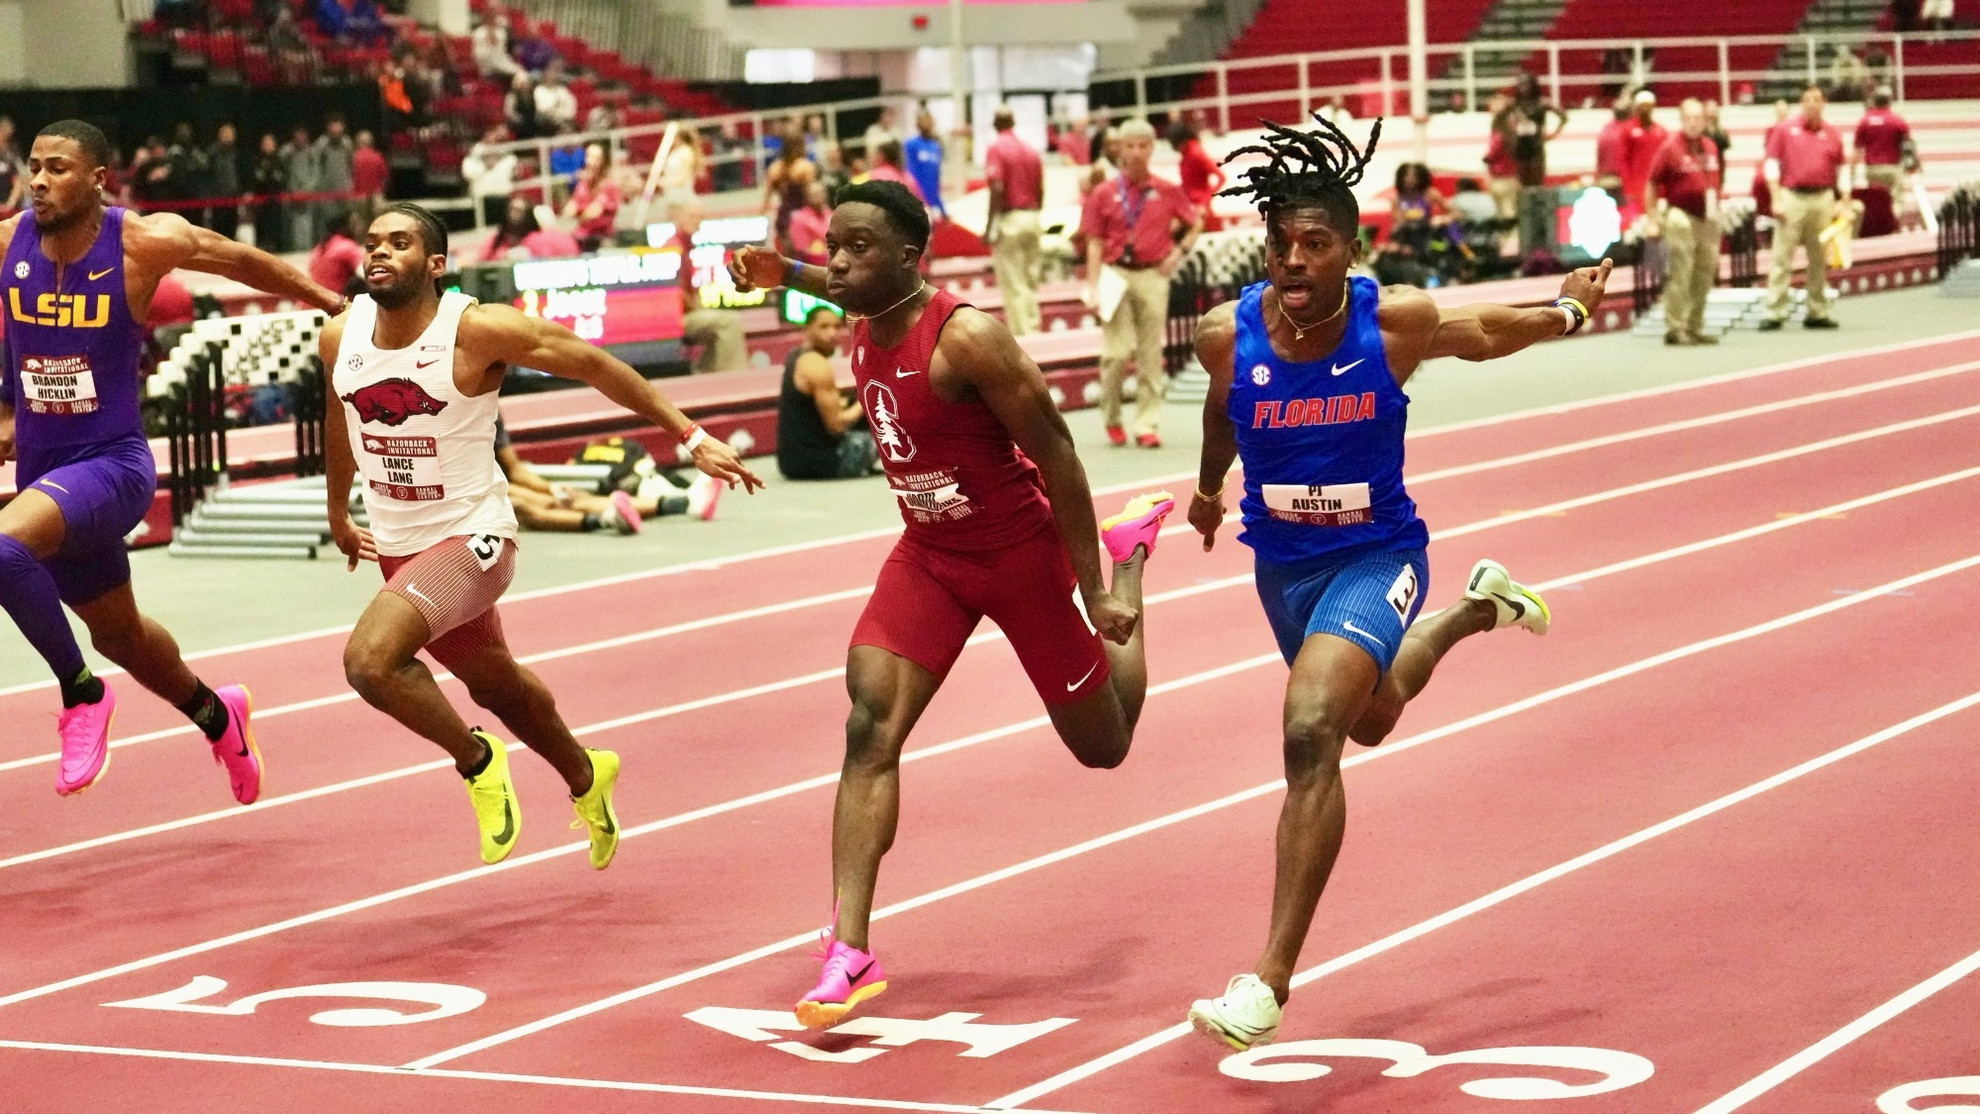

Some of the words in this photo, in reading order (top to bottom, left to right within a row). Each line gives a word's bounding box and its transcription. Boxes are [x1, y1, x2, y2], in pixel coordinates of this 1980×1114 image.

[8, 287, 110, 328] LSU
[32, 375, 78, 387] BRANDON
[1251, 363, 1271, 386] SEC
[37, 388, 76, 400] HICKLIN
[1251, 392, 1375, 429] FLORIDA
[386, 440, 427, 448] RAZORBACK
[387, 447, 435, 455] INVITATIONAL
[382, 457, 414, 470] LANCE
[387, 471, 414, 485] LANG
[905, 471, 945, 483] RAZORBACK
[1308, 486, 1323, 496] PJ
[1292, 499, 1343, 511] AUSTIN
[1393, 575, 1416, 615] 3
[98, 975, 487, 1027] 5
[1217, 1038, 1655, 1100] 3
